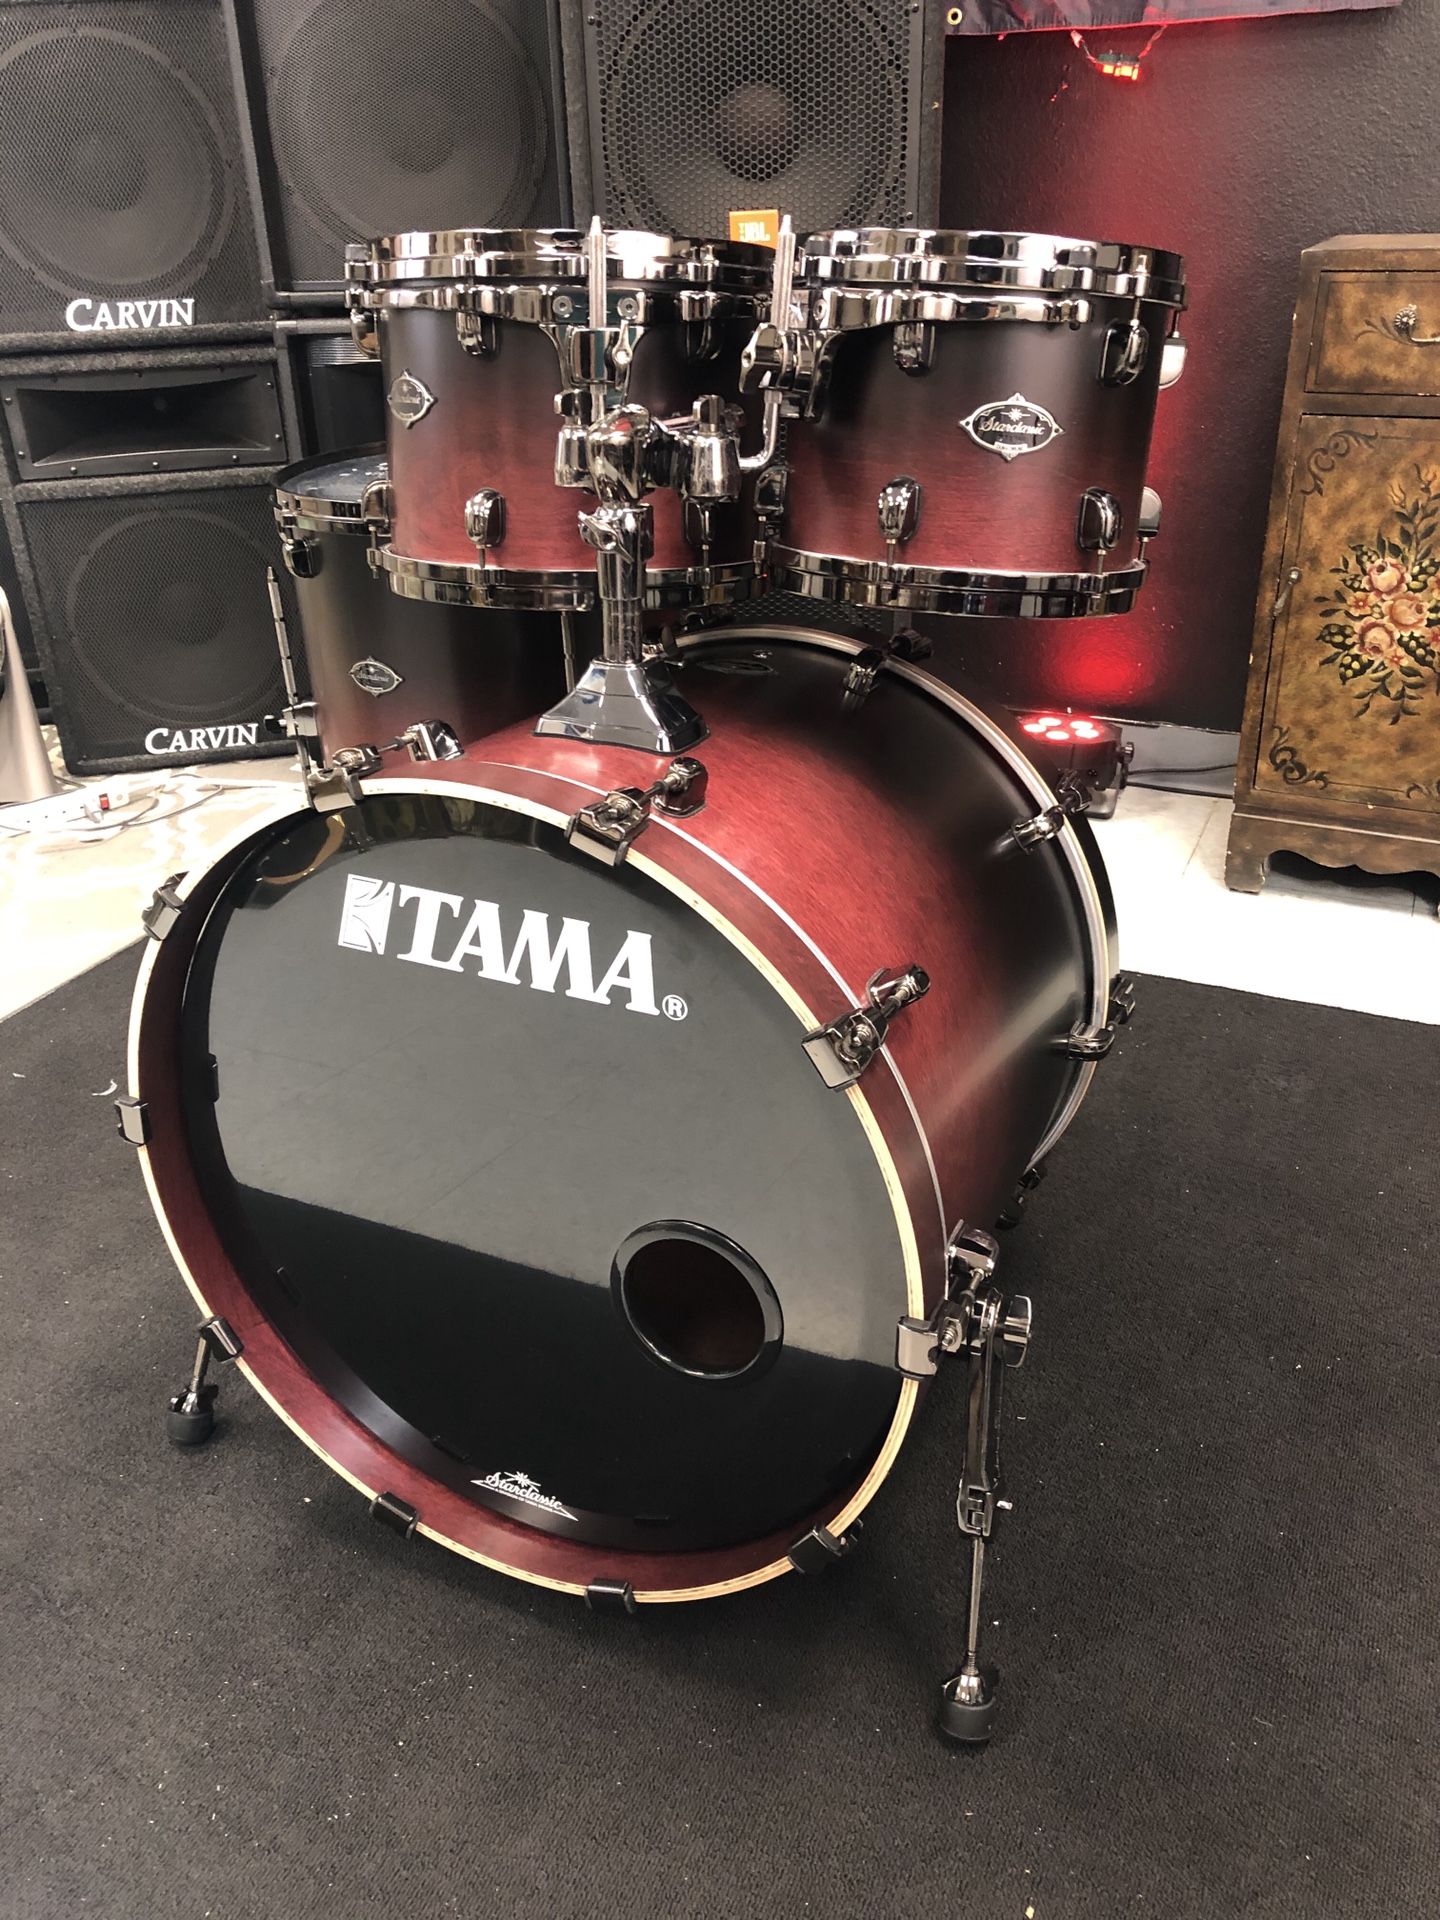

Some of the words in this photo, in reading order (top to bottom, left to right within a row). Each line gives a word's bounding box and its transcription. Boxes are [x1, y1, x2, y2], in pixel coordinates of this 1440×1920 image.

[65, 298, 195, 331] CARVIN
[145, 723, 258, 754] CARVIN
[397, 883, 661, 1016] TAMA
[484, 1472, 563, 1510] Starclassic
